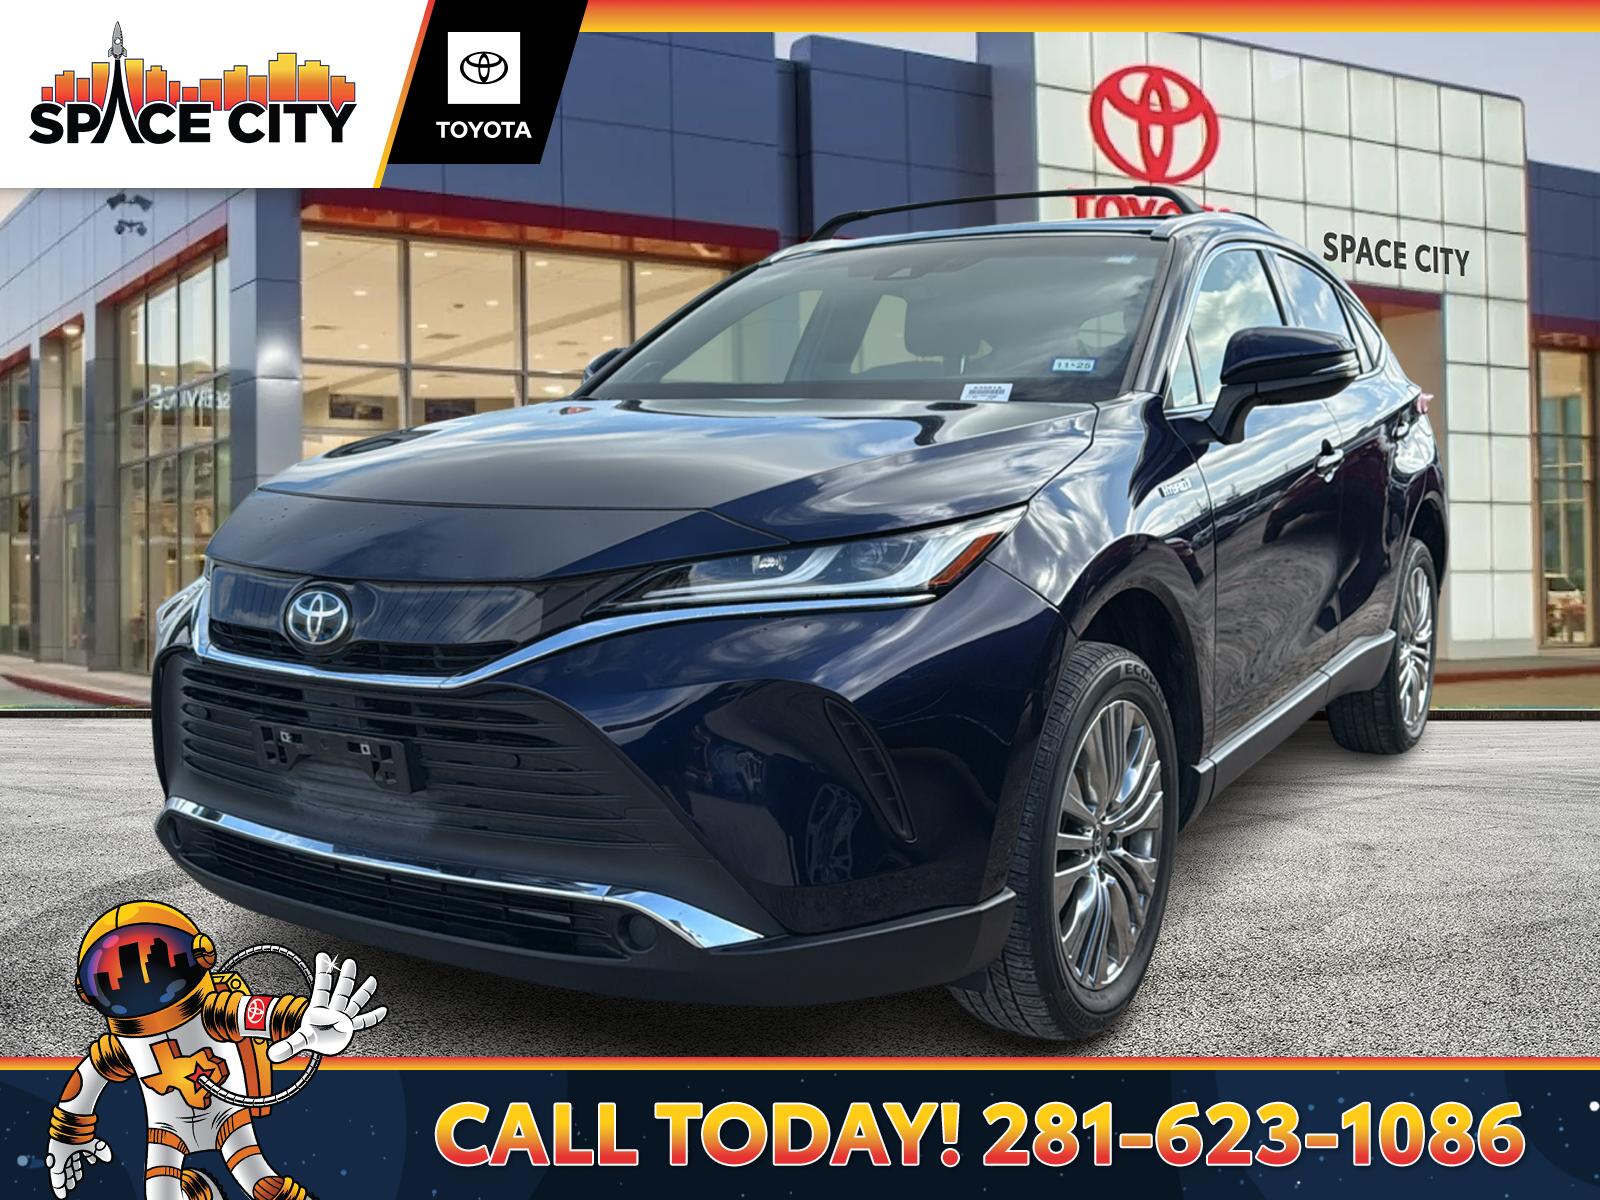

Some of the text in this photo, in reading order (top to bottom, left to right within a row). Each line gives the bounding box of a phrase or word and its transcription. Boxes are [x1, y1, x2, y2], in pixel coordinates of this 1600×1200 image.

[1067, 185, 1231, 218] TOY
[1323, 232, 1470, 277] SPACE CITY
